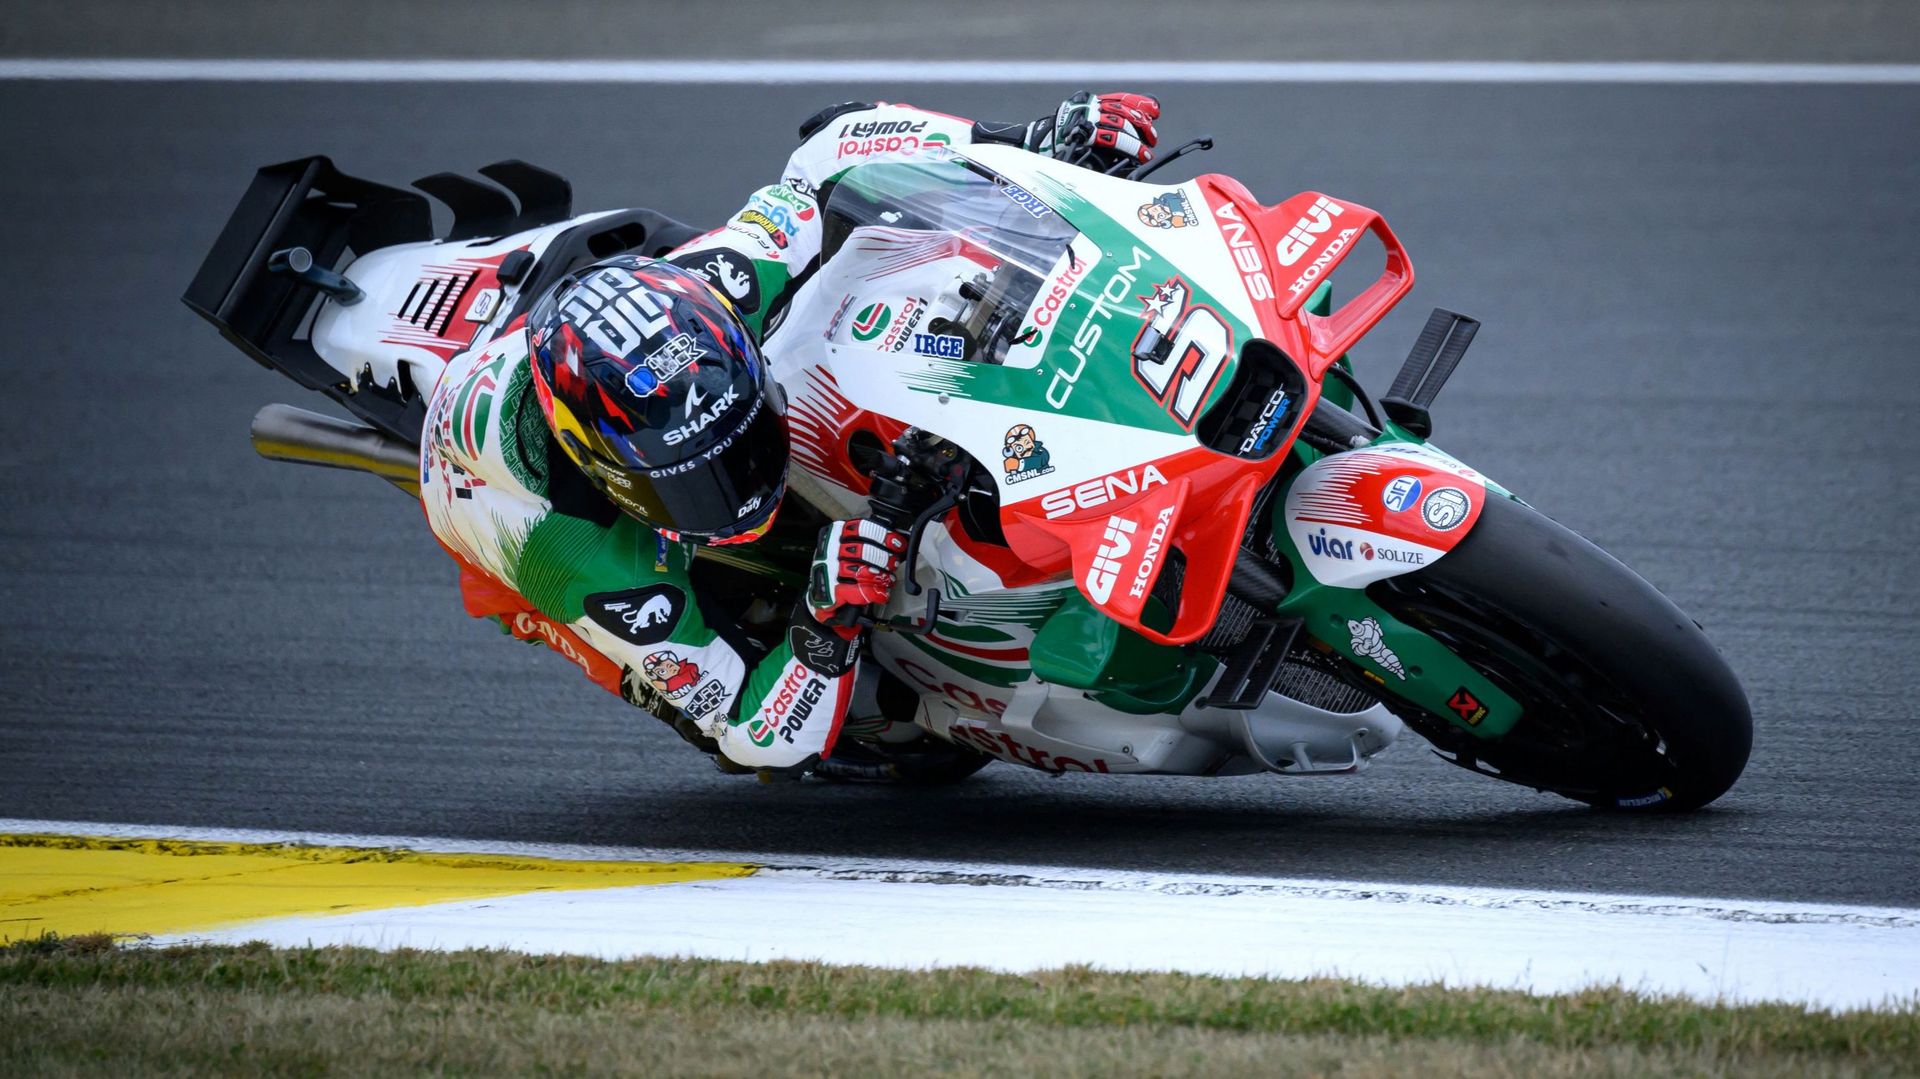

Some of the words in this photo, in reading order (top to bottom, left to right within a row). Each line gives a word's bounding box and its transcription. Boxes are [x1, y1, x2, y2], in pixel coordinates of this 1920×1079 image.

[837, 136, 919, 159] Castrol
[1003, 185, 1051, 217] IRGE
[1216, 202, 1275, 301] SENA
[1276, 196, 1344, 267] GIVI
[1288, 227, 1358, 295] HONDA
[1034, 256, 1087, 326] Castrol
[877, 296, 917, 352] astrol
[891, 297, 929, 353] OWER1
[914, 333, 963, 358] IRGE
[1046, 245, 1151, 409] CUSTOM
[662, 384, 740, 446] SHARK
[1239, 385, 1284, 456] DAYCO
[1254, 398, 1290, 451] POWER
[650, 461, 696, 478] GIVES
[702, 435, 732, 460] YOU
[1041, 464, 1168, 520] SENA
[1085, 515, 1138, 605] GIVI
[1129, 505, 1175, 599] HONDA
[1377, 549, 1425, 565] SOLIZE
[687, 680, 722, 712] QUAD
[692, 689, 731, 720] LOCK
[764, 663, 808, 728] Castro
[779, 677, 827, 744] POWER
